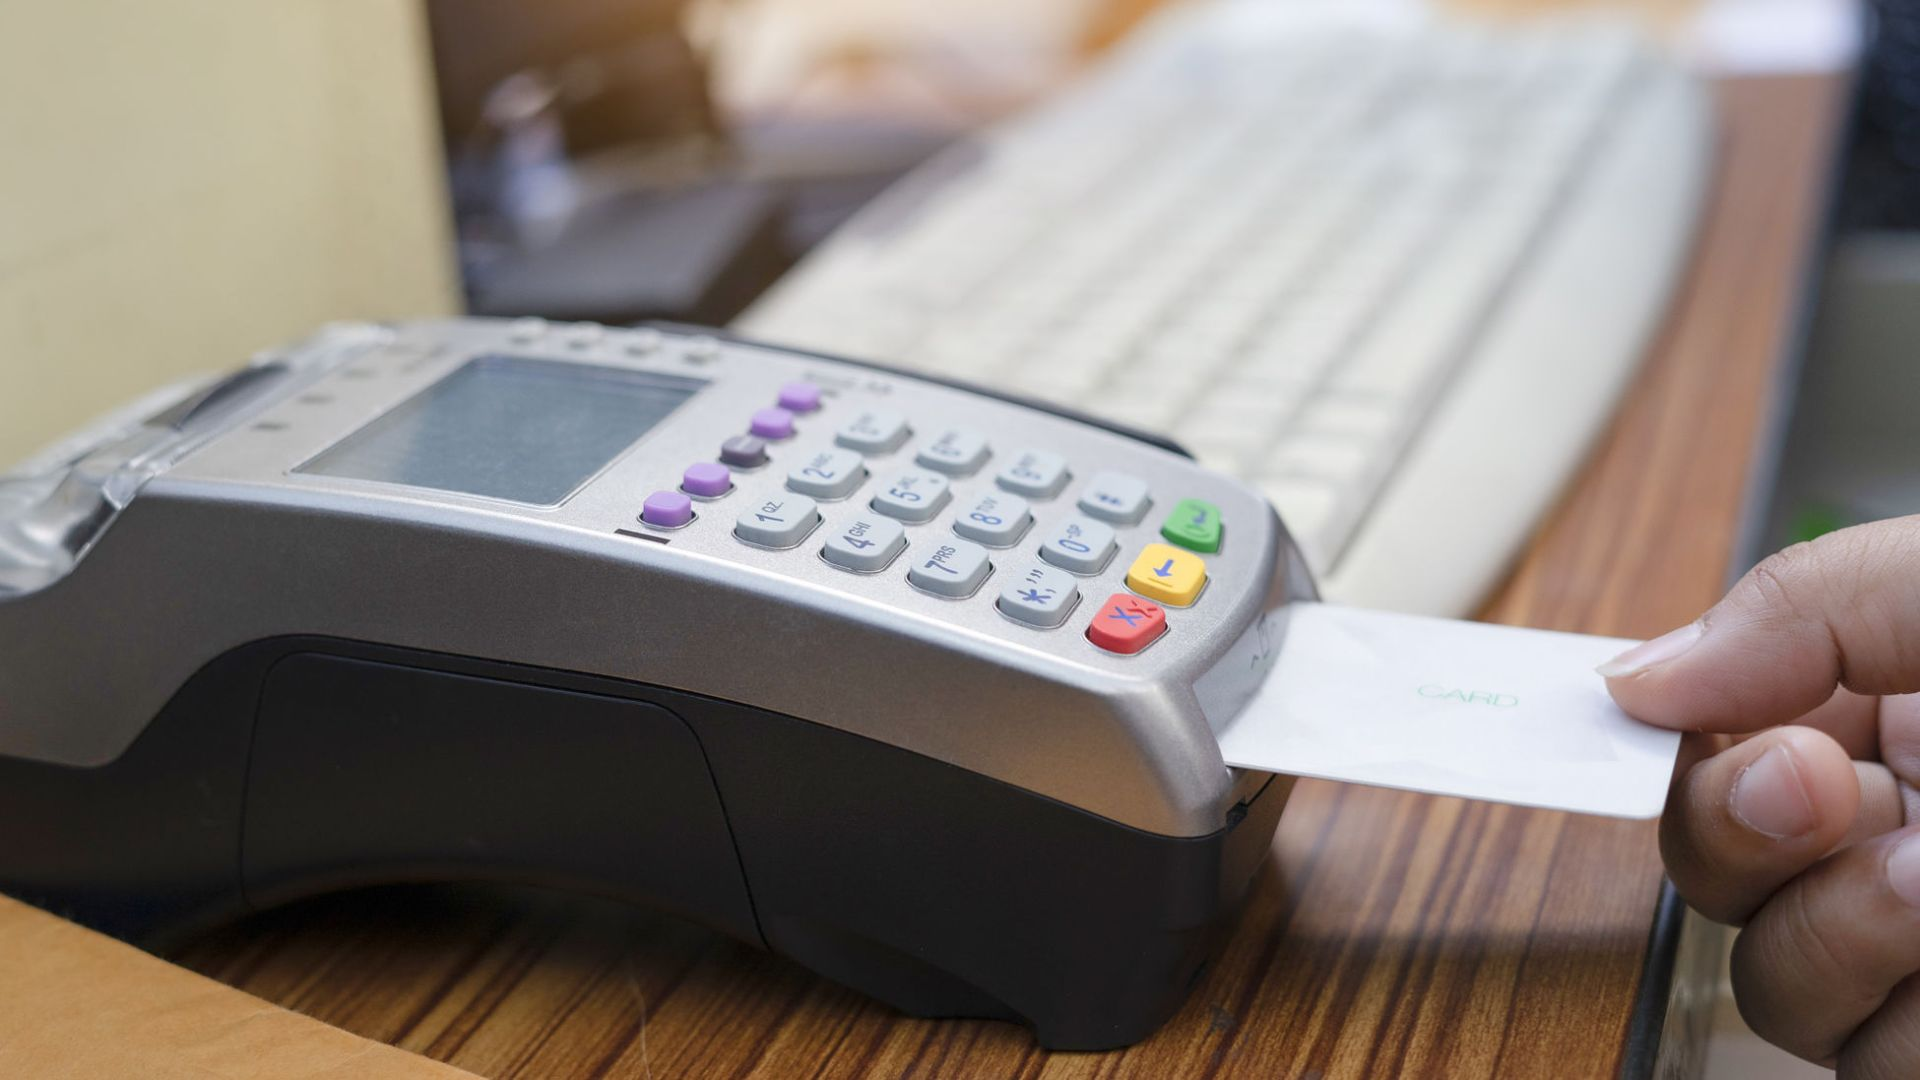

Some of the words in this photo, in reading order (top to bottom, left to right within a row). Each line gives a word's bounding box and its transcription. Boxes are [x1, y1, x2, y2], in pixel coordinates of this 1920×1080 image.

[889, 487, 921, 502] 5
[969, 512, 1003, 526] 8
[1417, 684, 1519, 707] CARD
